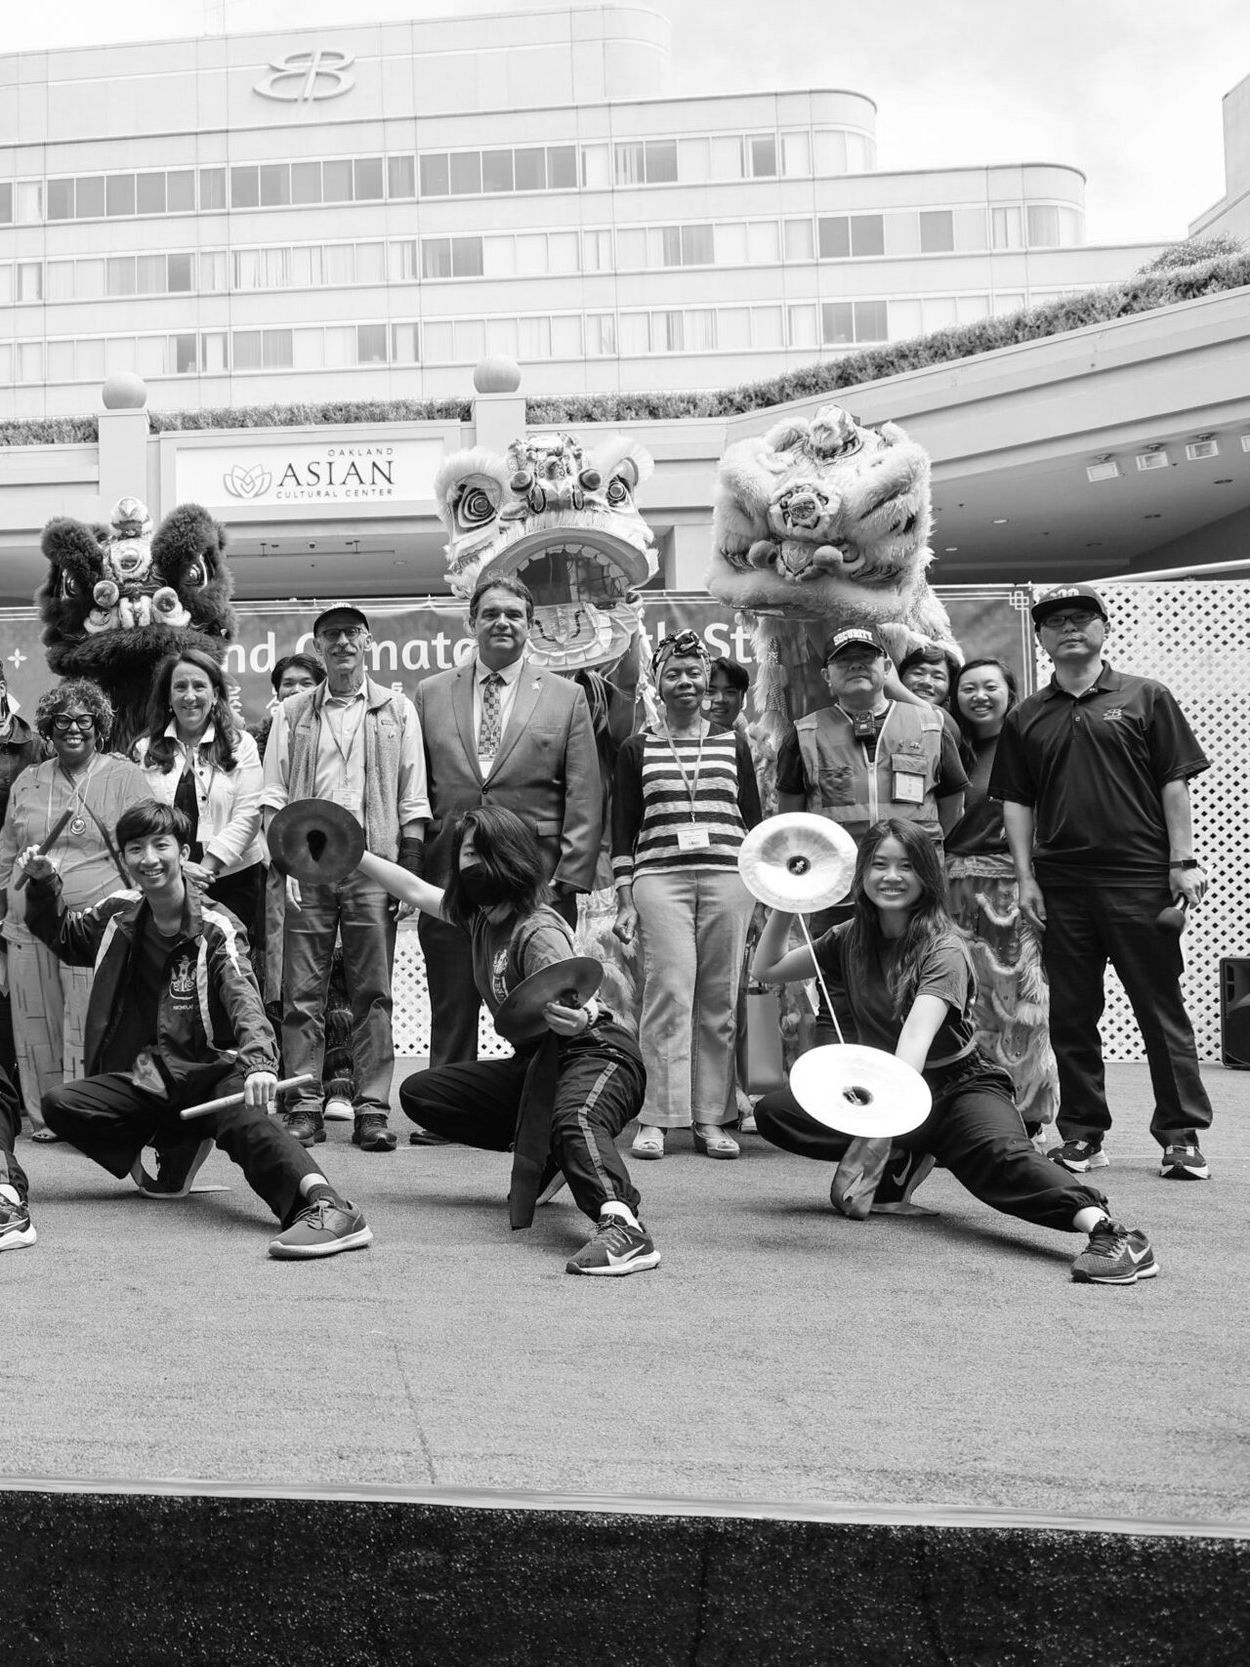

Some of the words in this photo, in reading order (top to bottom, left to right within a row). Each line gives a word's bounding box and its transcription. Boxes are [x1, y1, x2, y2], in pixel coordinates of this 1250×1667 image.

[327, 447, 393, 457] OAKLAND
[276, 460, 395, 487] ASIAN
[276, 490, 338, 499] CULTURAL
[345, 488, 393, 498] CENTER
[833, 628, 873, 646] SECURITY
